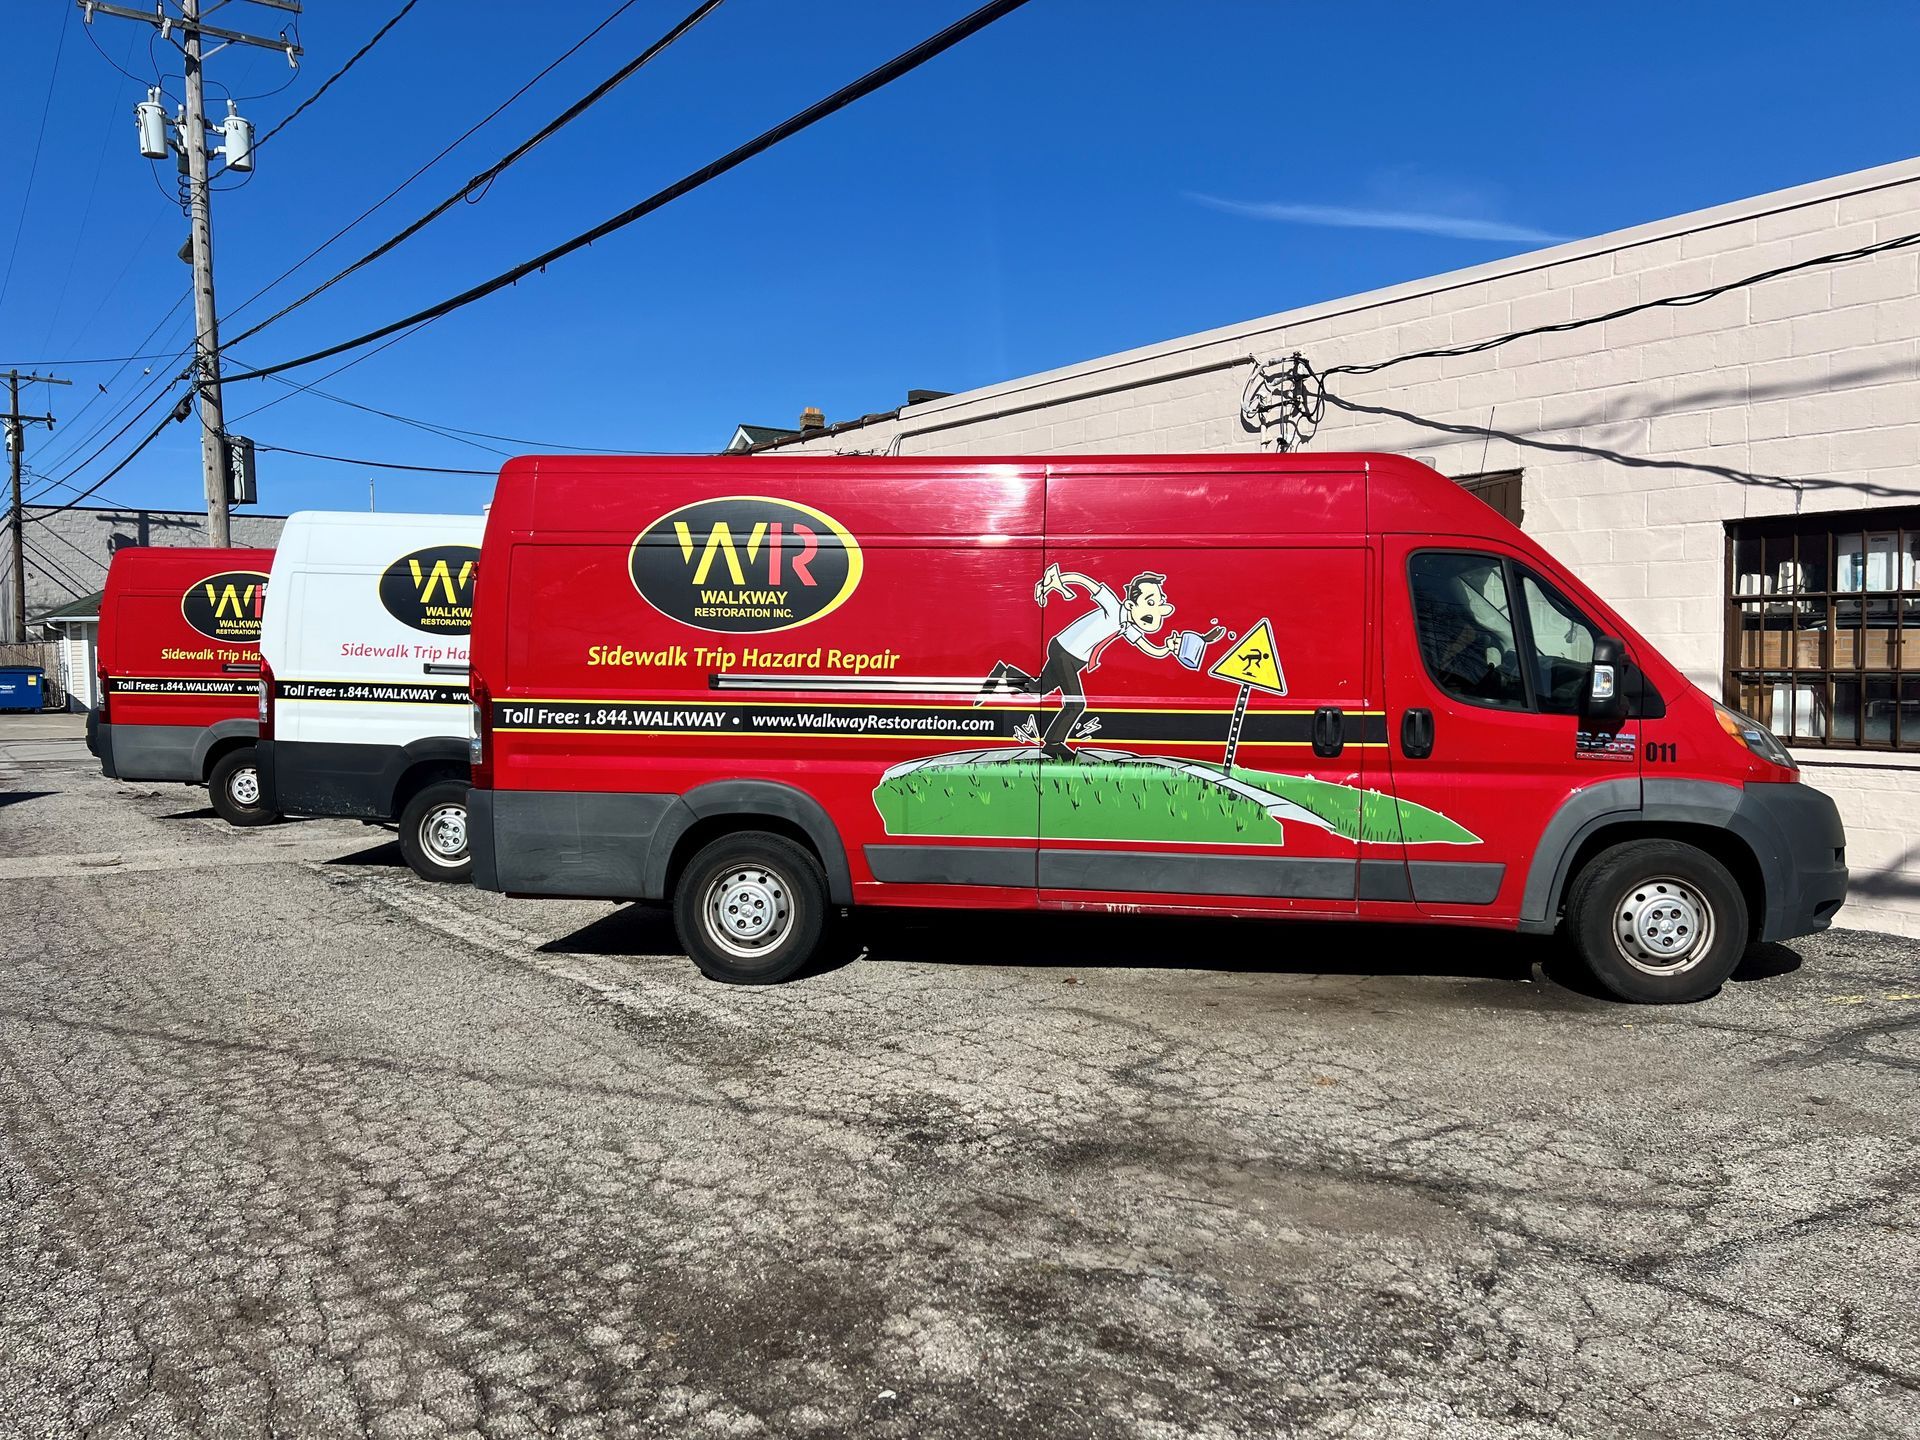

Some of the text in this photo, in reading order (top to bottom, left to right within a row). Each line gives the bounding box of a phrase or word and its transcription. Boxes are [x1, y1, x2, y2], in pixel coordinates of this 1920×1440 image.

[701, 590, 788, 605] WALKWAY
[425, 606, 473, 618] WALKW
[694, 607, 794, 619] RESTORATION INC.
[161, 648, 214, 660] Sidewalk
[217, 650, 239, 664] Trip
[341, 643, 409, 659] Sidewalk
[414, 645, 442, 663] Trip
[587, 645, 901, 674] Sidewalk Trip Hazard Repair
[117, 681, 134, 690] Toll
[135, 681, 159, 691] Free:
[160, 682, 235, 692] 1.844.WALKWAY
[283, 684, 305, 697] Toll
[307, 685, 337, 698] Free:
[339, 687, 438, 701] 1.844.WALKWAY
[503, 708, 727, 727] Toll Free: 1.844.WALKWAY
[752, 713, 995, 732] www.WalkwayRestoration.com
[1645, 741, 1677, 763] 011
